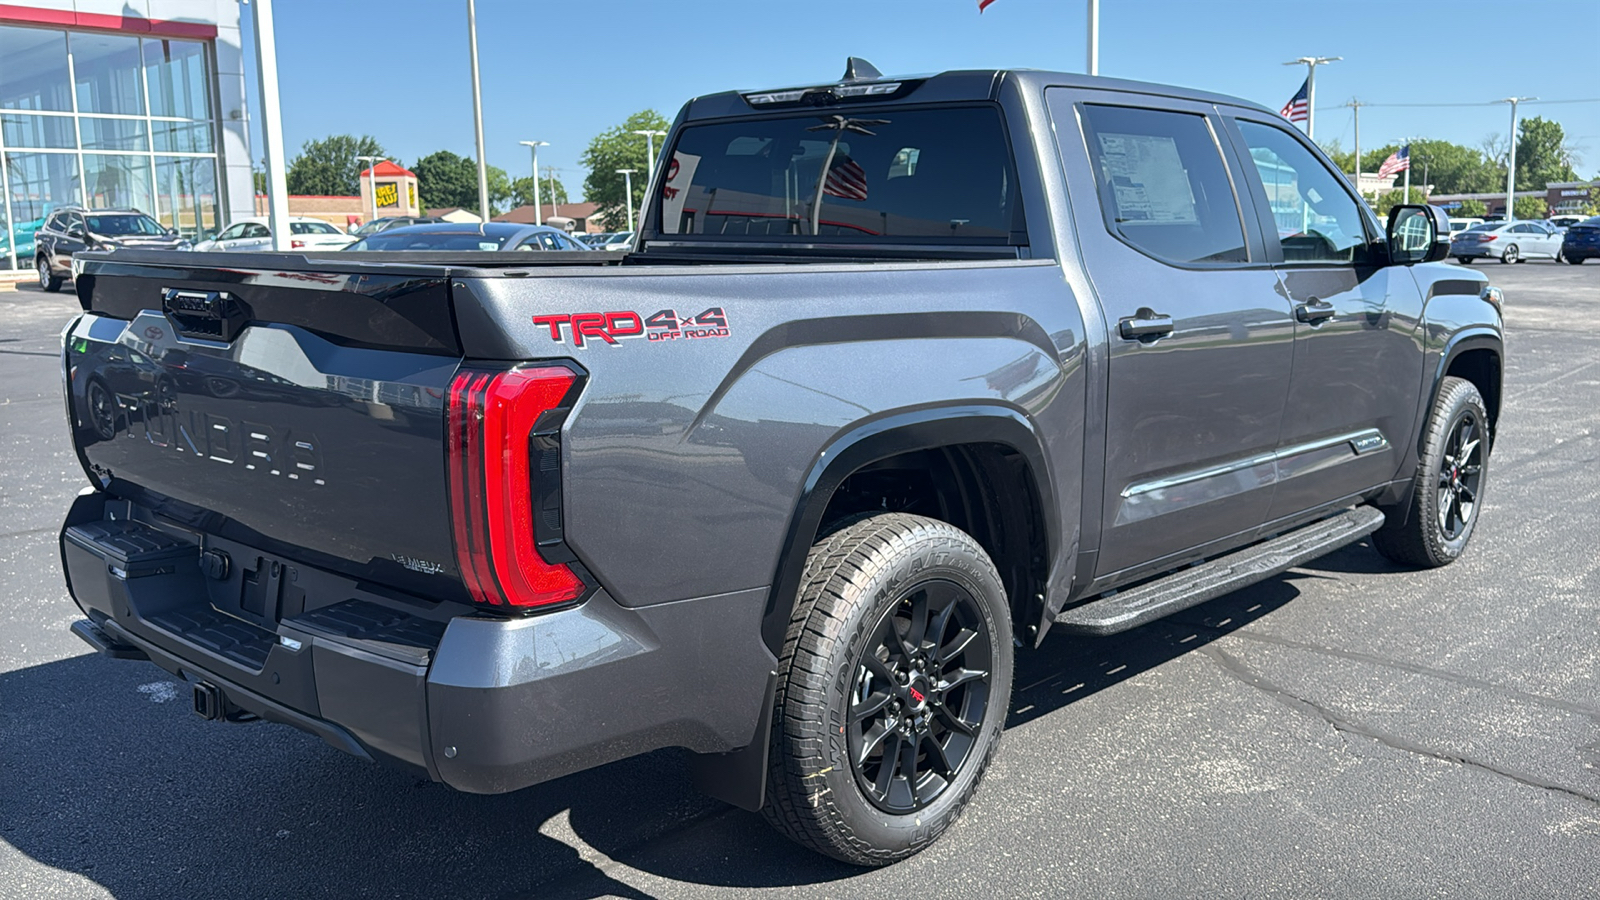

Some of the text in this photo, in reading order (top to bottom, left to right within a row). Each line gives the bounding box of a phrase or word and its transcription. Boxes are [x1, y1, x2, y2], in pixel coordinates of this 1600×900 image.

[376, 193, 398, 207] PLUS
[532, 310, 645, 349] TRD
[647, 328, 730, 342] OFF ROAD
[115, 392, 325, 487] TUNDRA
[910, 686, 925, 702] TRD
